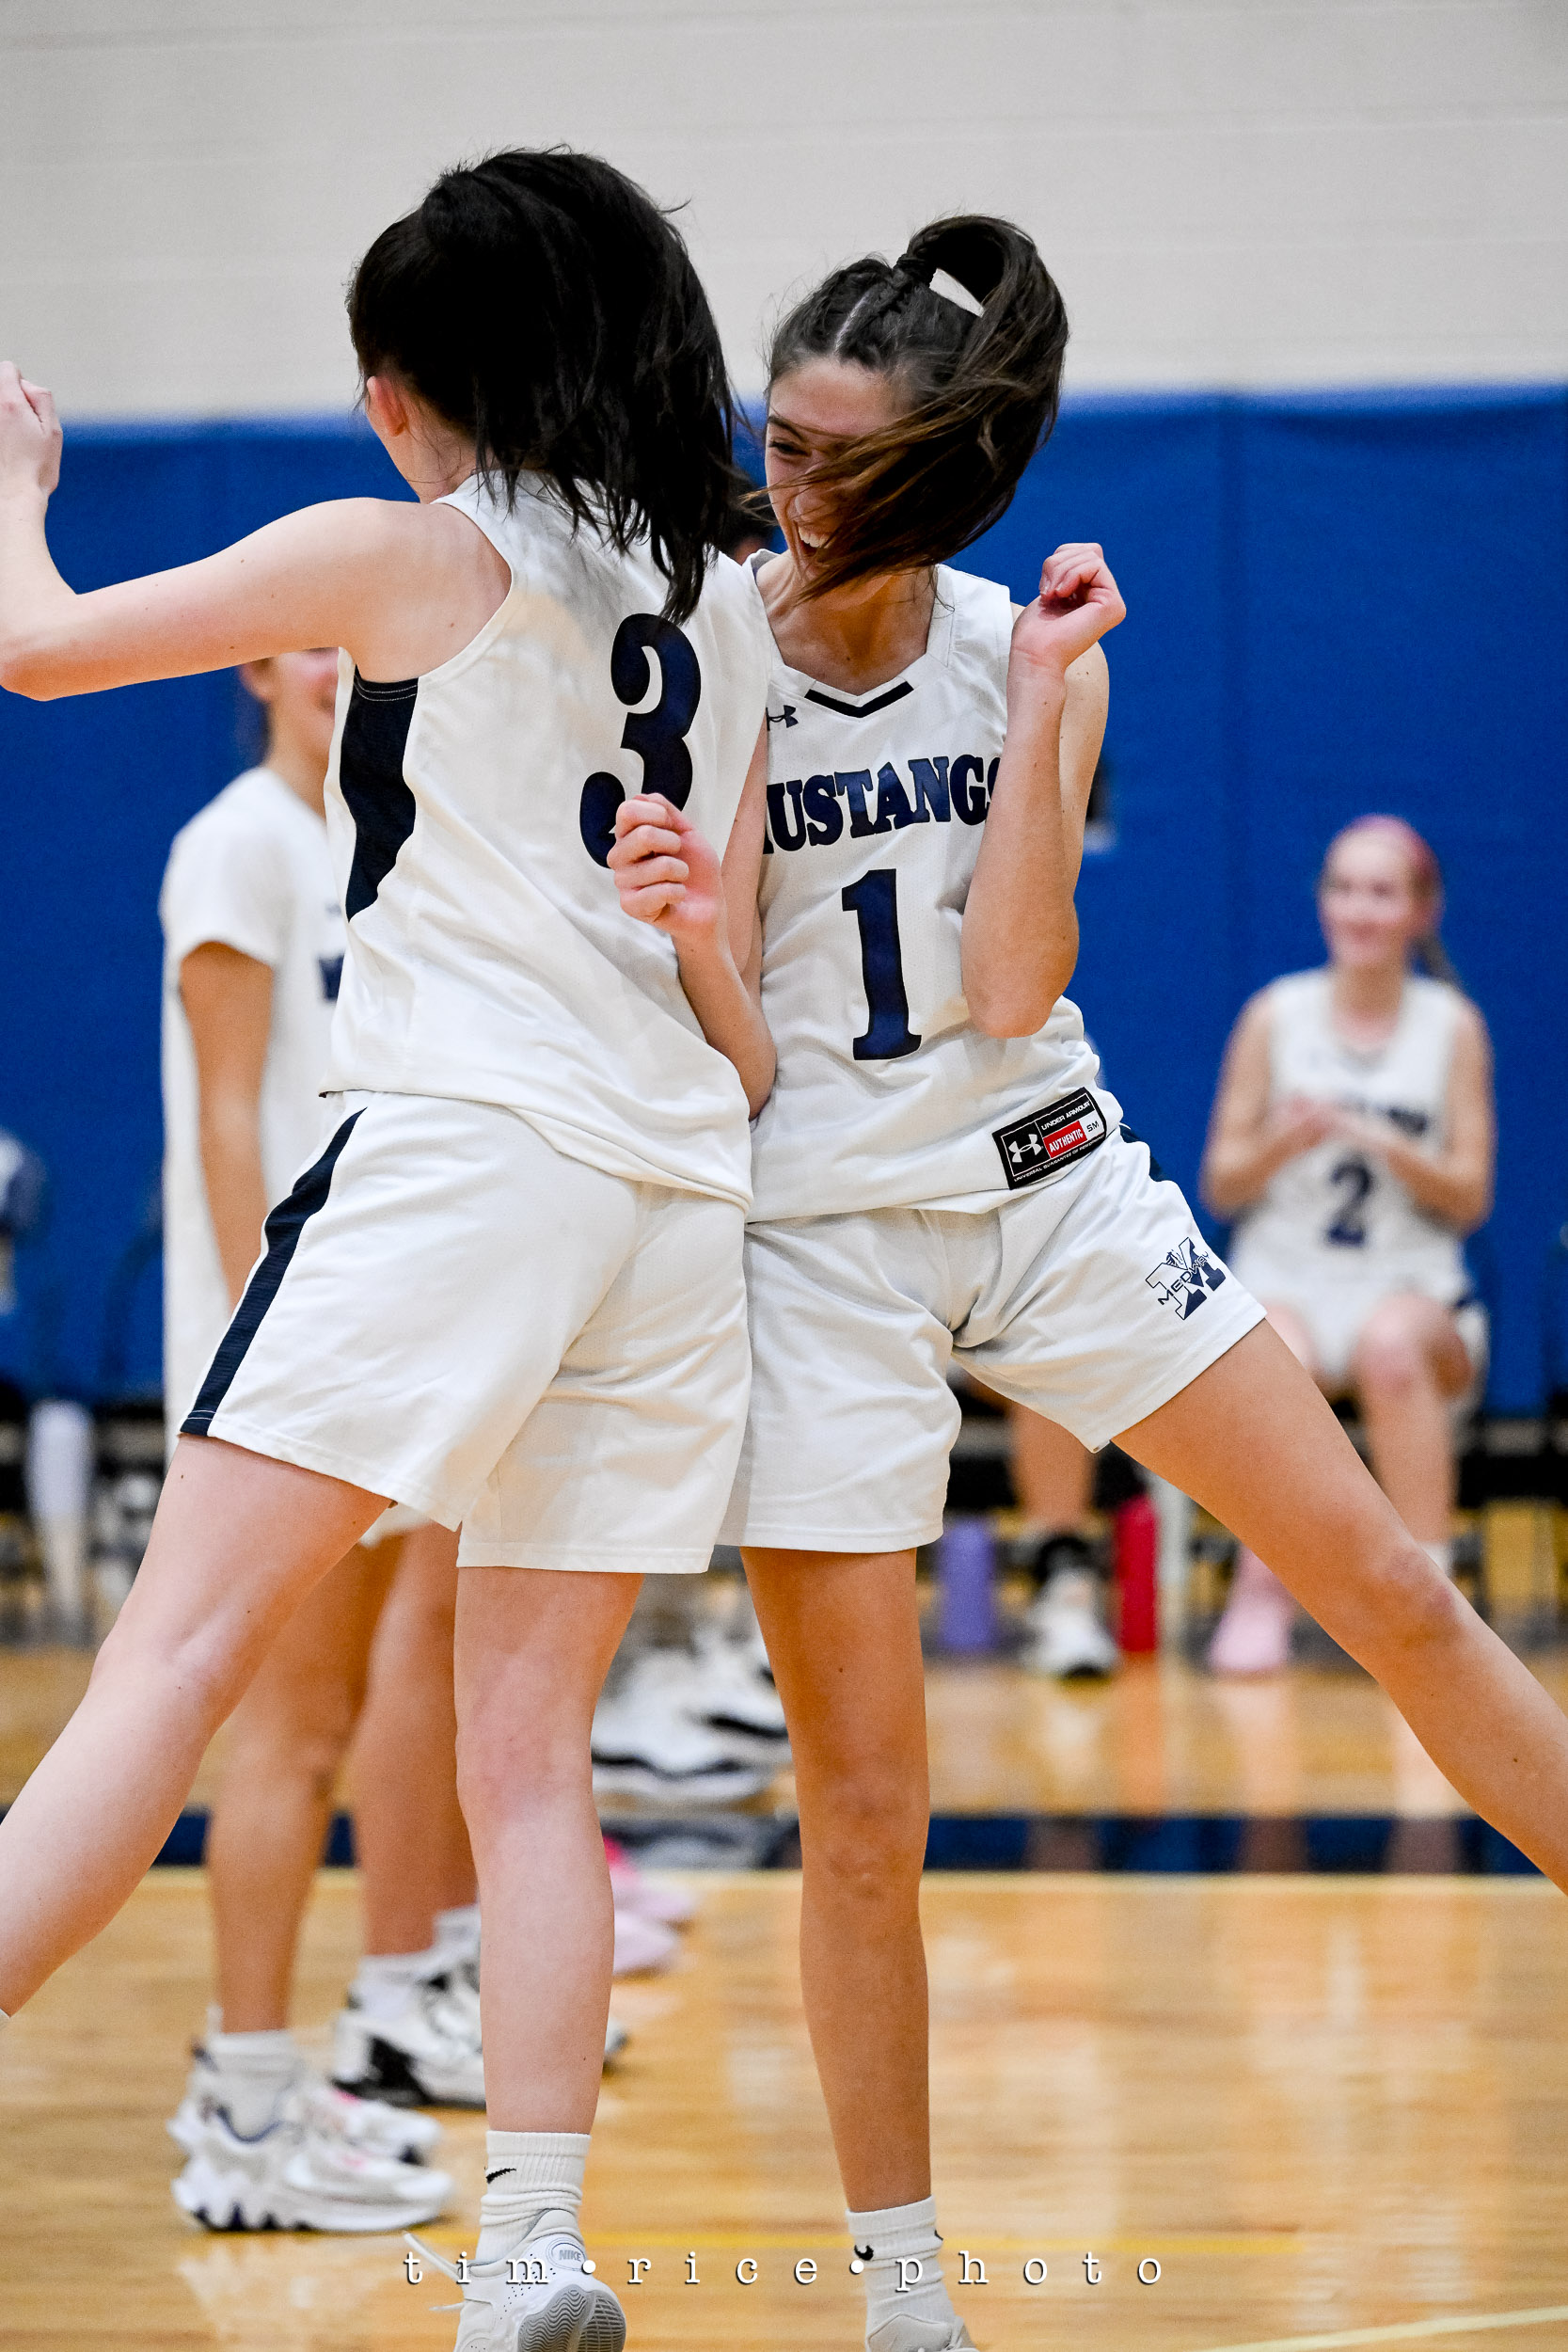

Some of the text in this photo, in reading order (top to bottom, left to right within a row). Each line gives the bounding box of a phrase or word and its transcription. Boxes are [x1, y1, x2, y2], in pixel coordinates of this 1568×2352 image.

[579, 612, 702, 869] 3
[763, 755, 1001, 855] USTANG
[841, 867, 923, 1061] 1
[1041, 1101, 1090, 1131] UNDER ARMOUR
[1048, 1120, 1100, 1153] AUTHENTIC SM
[1326, 1153, 1373, 1245] 2
[559, 2249, 582, 2262] NIKE
